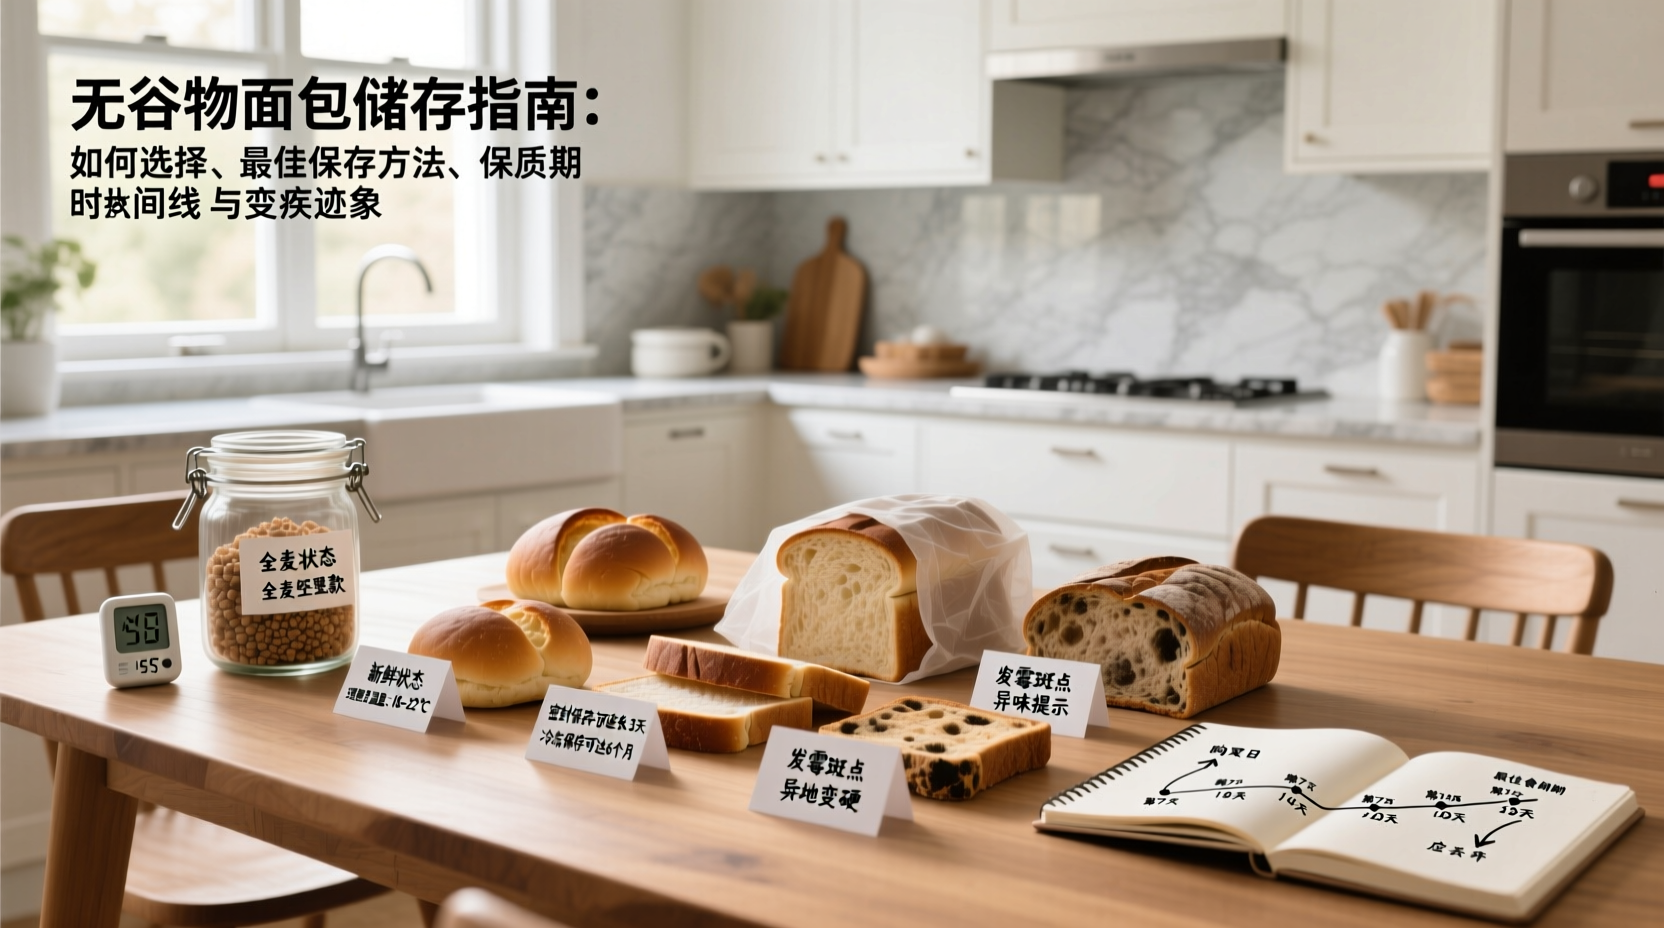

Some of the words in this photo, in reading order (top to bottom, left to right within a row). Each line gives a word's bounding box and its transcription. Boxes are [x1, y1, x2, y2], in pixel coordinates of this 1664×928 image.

[259, 545, 337, 573] 全麦状态
[367, 661, 425, 690] 新鲜状态
[993, 690, 1069, 716] 异味提示
